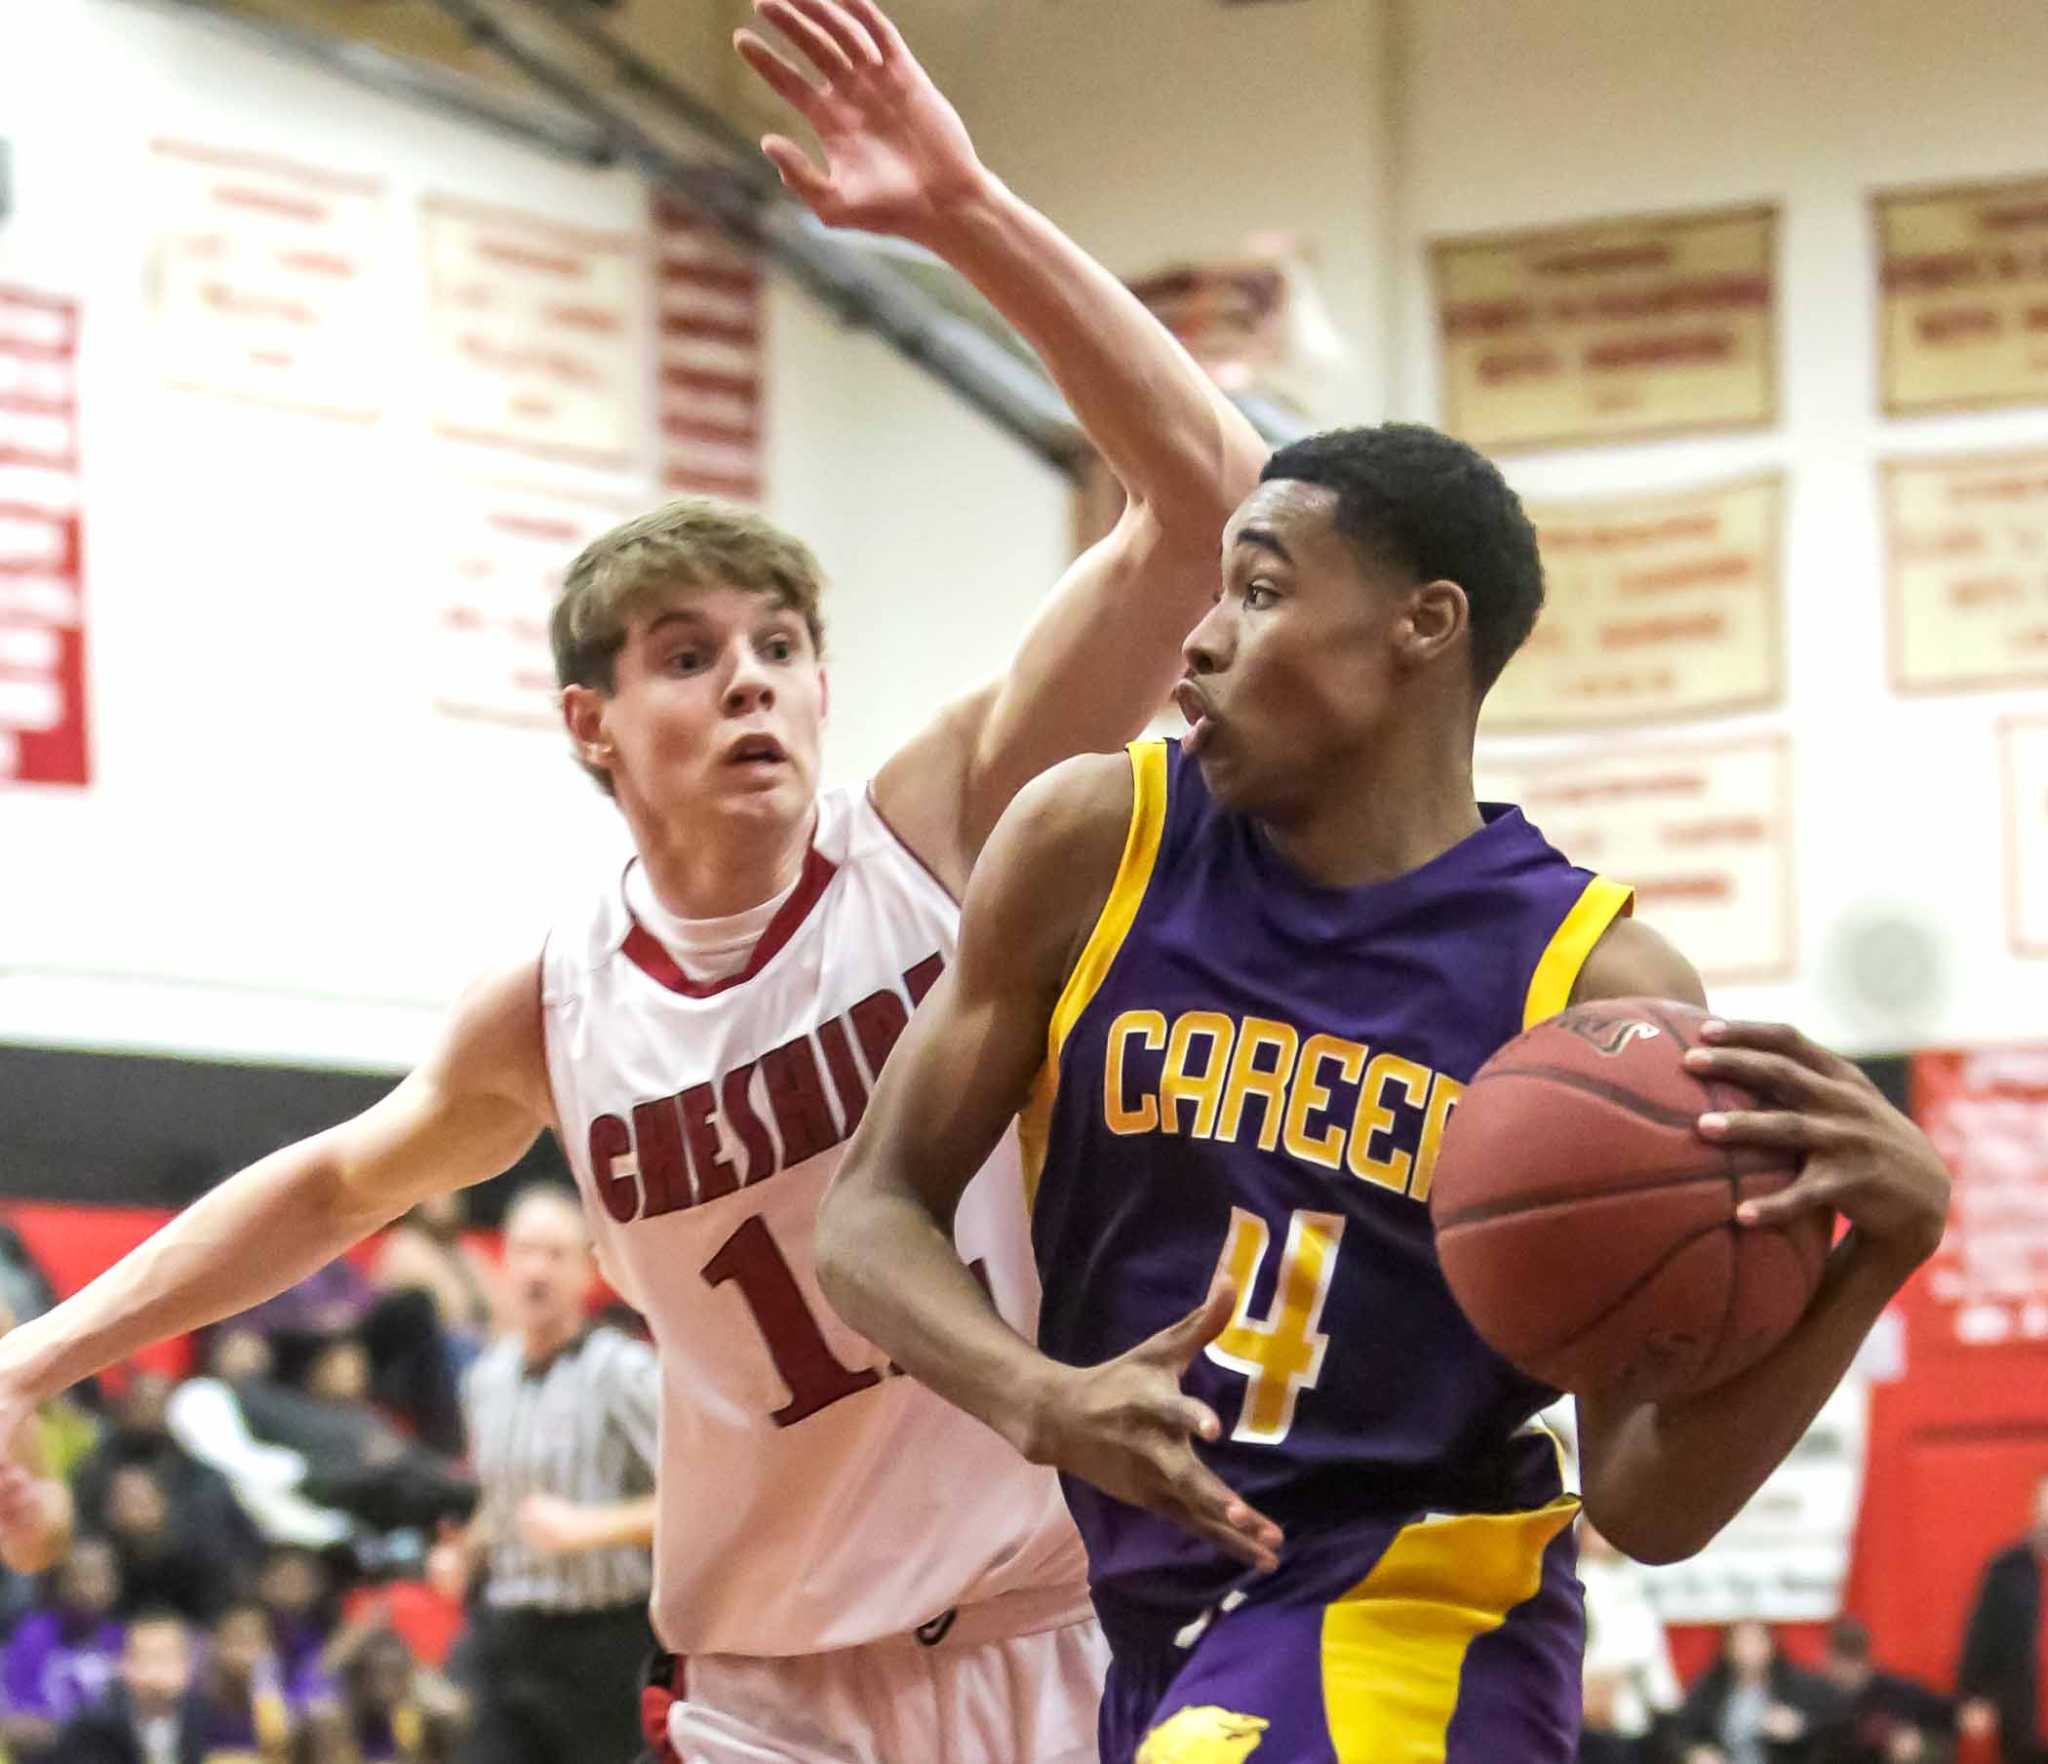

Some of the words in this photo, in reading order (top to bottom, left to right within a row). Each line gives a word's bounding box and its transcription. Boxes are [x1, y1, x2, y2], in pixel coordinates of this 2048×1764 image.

[589, 950, 946, 1223] CHESHI
[700, 1214, 998, 1427] 1
[1204, 1205, 1346, 1445] 4
